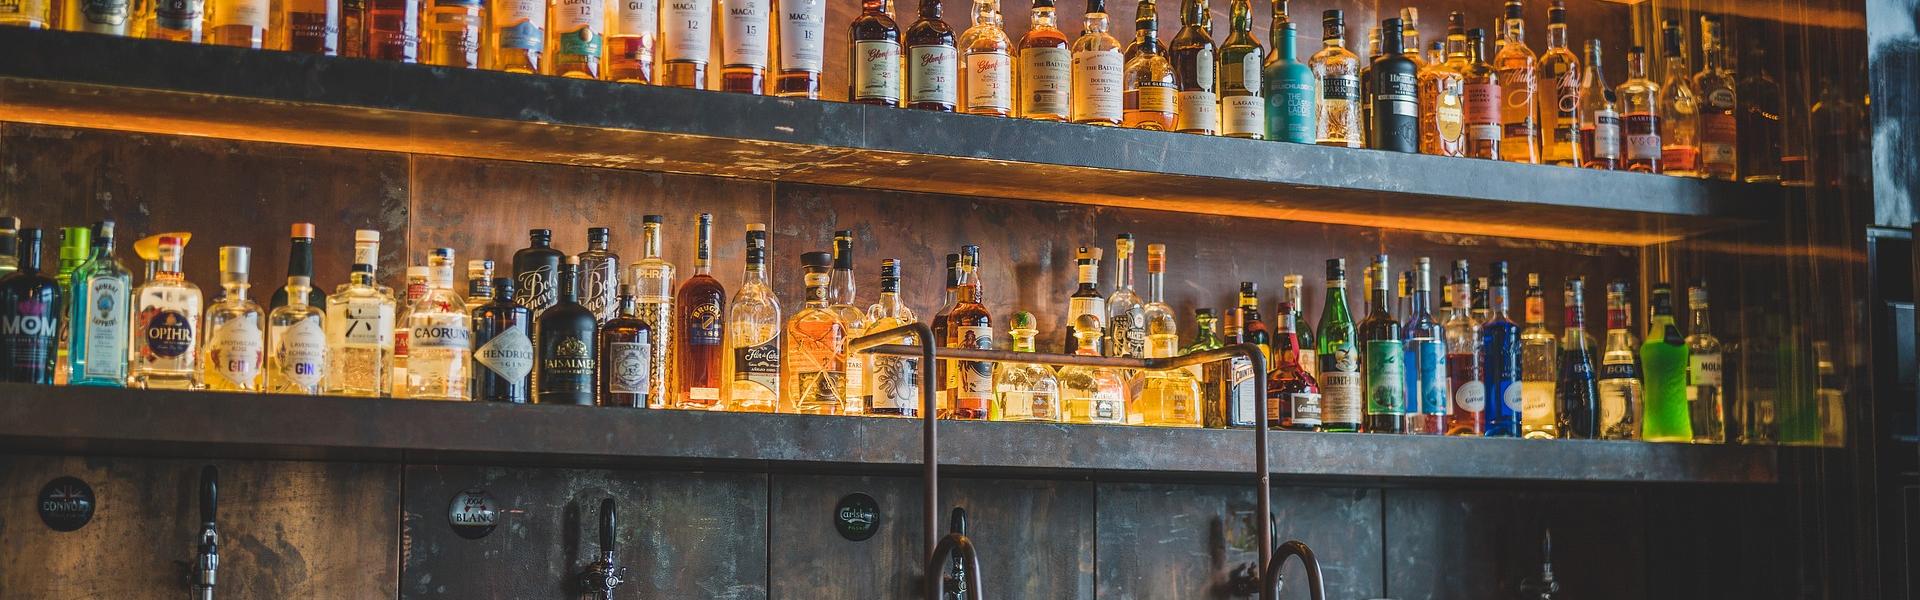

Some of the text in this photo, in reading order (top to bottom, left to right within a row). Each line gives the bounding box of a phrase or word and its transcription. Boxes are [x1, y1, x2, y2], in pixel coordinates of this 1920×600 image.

[580, 6, 592, 15] 12
[688, 20, 698, 29] 12
[746, 25, 757, 34] 15
[1288, 92, 1302, 100] THE
[693, 305, 721, 320] BRUGAL
[3, 314, 57, 337] MOM
[149, 327, 192, 341] OPIHR
[295, 362, 314, 375] GIN
[456, 511, 495, 523] BLANC
